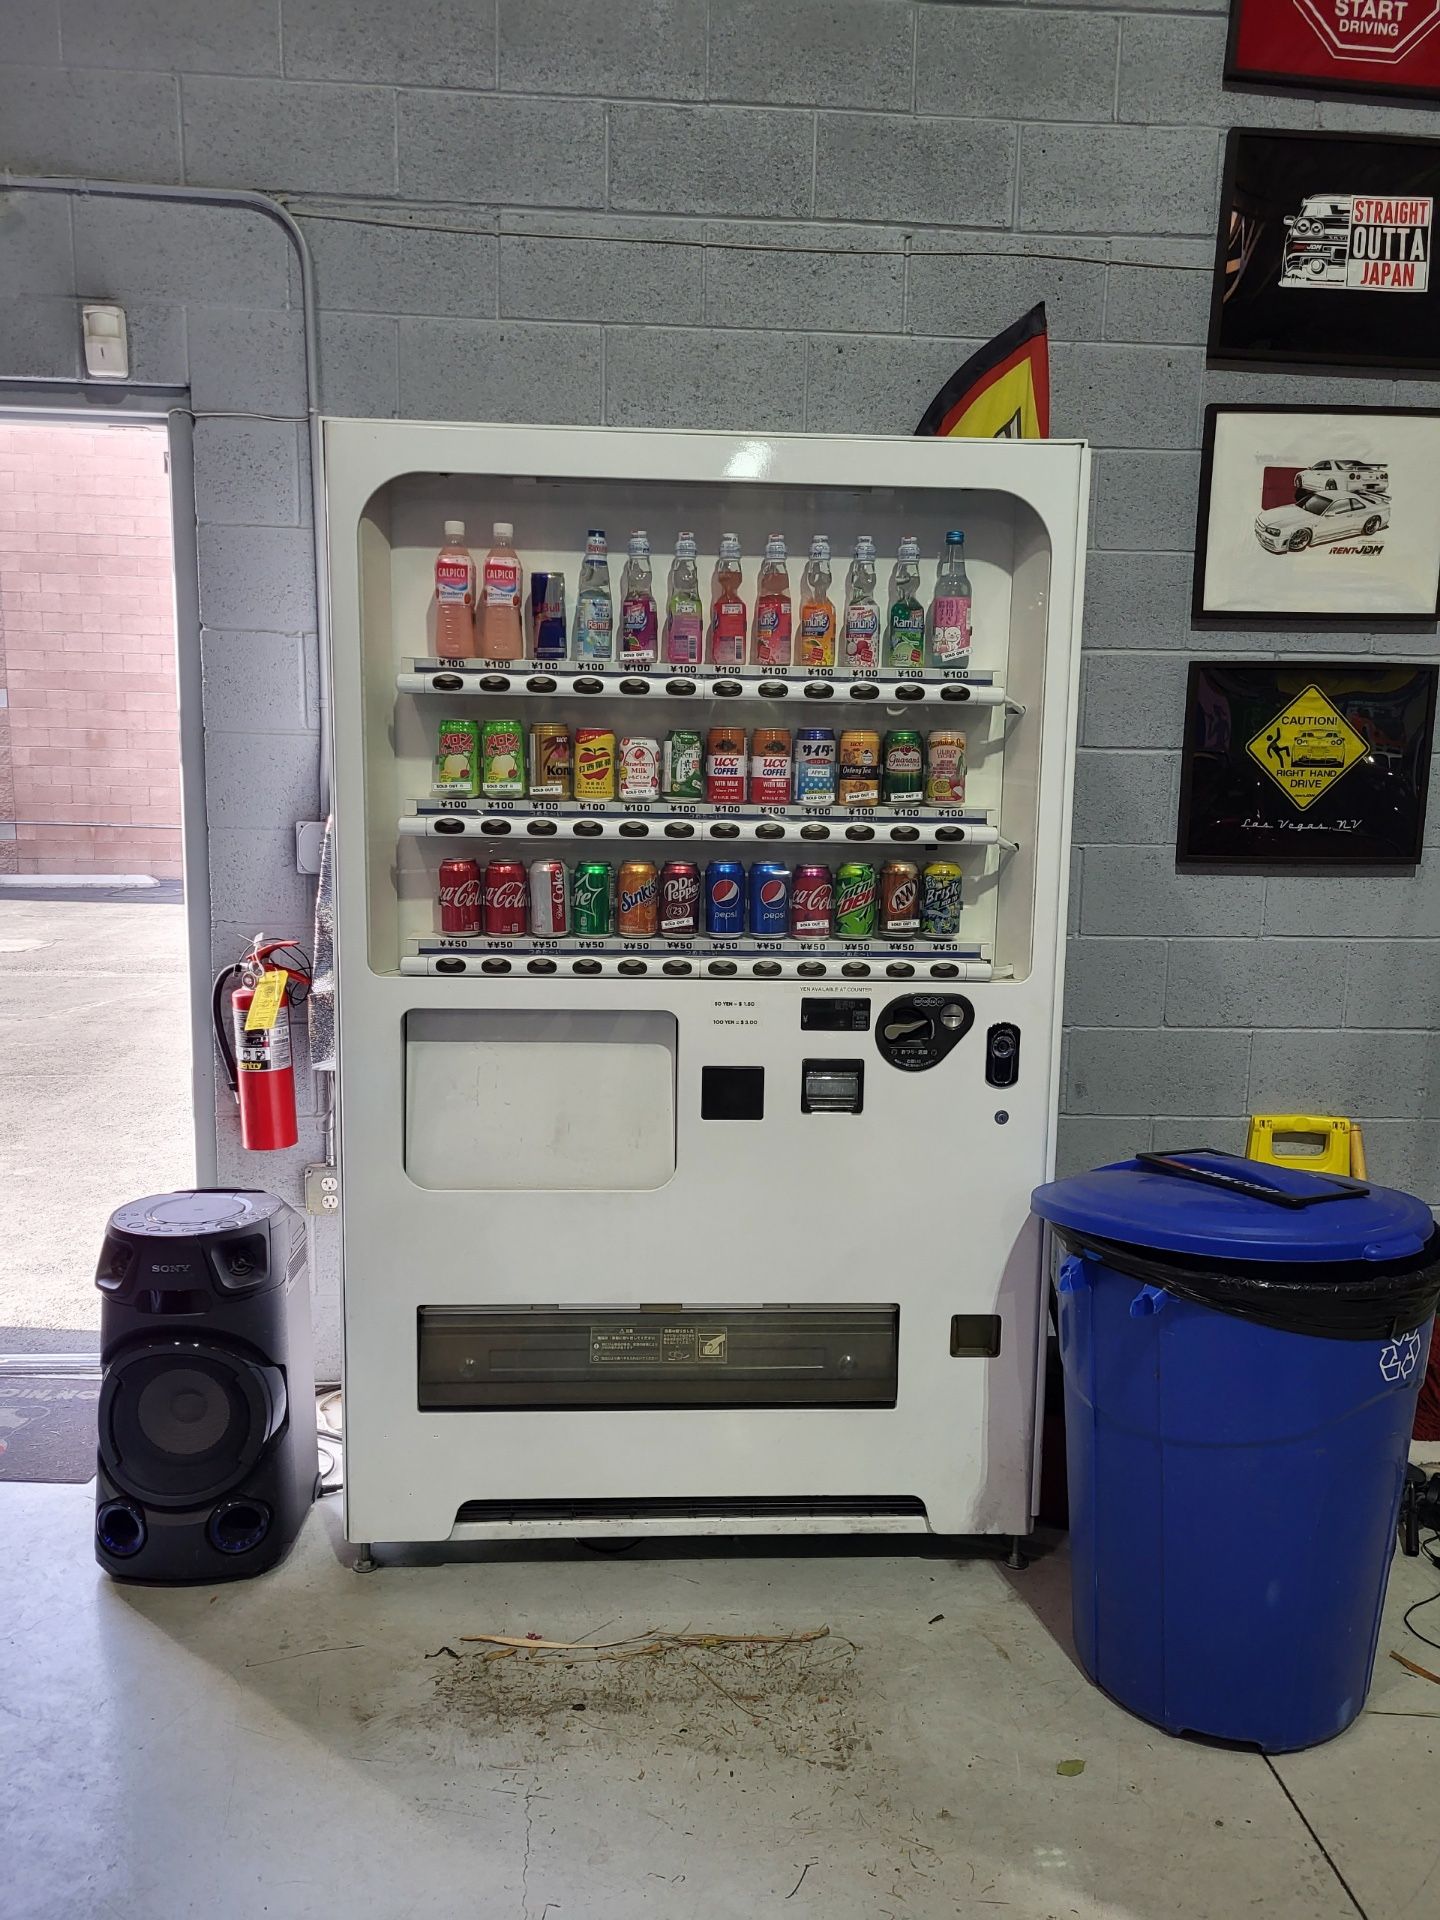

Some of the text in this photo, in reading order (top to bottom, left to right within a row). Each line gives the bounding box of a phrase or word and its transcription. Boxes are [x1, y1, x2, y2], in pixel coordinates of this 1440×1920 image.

[1334, 0, 1409, 21] START
[1339, 19, 1399, 36] DRIVING
[1354, 200, 1428, 224] STRAIGHT
[1352, 226, 1425, 261] OUTTA
[1360, 262, 1415, 287] JAPAN
[1329, 545, 1384, 555] RENTJDM
[438, 567, 466, 577] CALPICO
[486, 569, 514, 579] CALPICO
[439, 660, 465, 668] ¥100
[484, 661, 511, 669] ¥100
[531, 662, 558, 670] ¥100
[578, 663, 604, 671] ¥100
[624, 663, 650, 672] ¥100
[670, 665, 697, 673] ¥100
[715, 665, 741, 674] ¥100
[761, 666, 788, 675] ¥100
[808, 667, 834, 676] ¥100
[852, 669, 878, 677] ¥100
[898, 670, 923, 678] ¥100
[943, 670, 969, 679] ¥100
[1281, 716, 1338, 726] CAUTION!
[714, 757, 739, 767] UCC
[763, 758, 787, 768] UCC
[1276, 769, 1337, 778] RIGHT HAND
[1290, 780, 1322, 788] DRIVE
[441, 800, 467, 809] ¥100
[488, 801, 514, 809] ¥100
[532, 802, 558, 810] ¥100
[580, 803, 605, 811] ¥100
[624, 804, 650, 812] ¥100
[670, 805, 696, 813] ¥100
[715, 805, 740, 813] ¥100
[760, 806, 786, 814] ¥100
[805, 807, 831, 815] ¥100
[849, 808, 874, 816] ¥100
[894, 809, 919, 817] ¥100
[938, 809, 964, 817] ¥100
[1240, 818, 1274, 829] Las
[1334, 819, 1364, 832] NV
[552, 869, 564, 904] Coke
[679, 877, 694, 890] Dr
[667, 880, 700, 902] Pepper
[672, 907, 682, 915] 23
[714, 910, 738, 919] pepsi
[763, 911, 786, 920] pepsi
[800, 943, 826, 951] ¥¥50
[845, 943, 870, 951] ¥¥50
[889, 943, 915, 951] ¥¥50
[932, 943, 958, 951] ¥¥50
[151, 1264, 192, 1273] SONY
